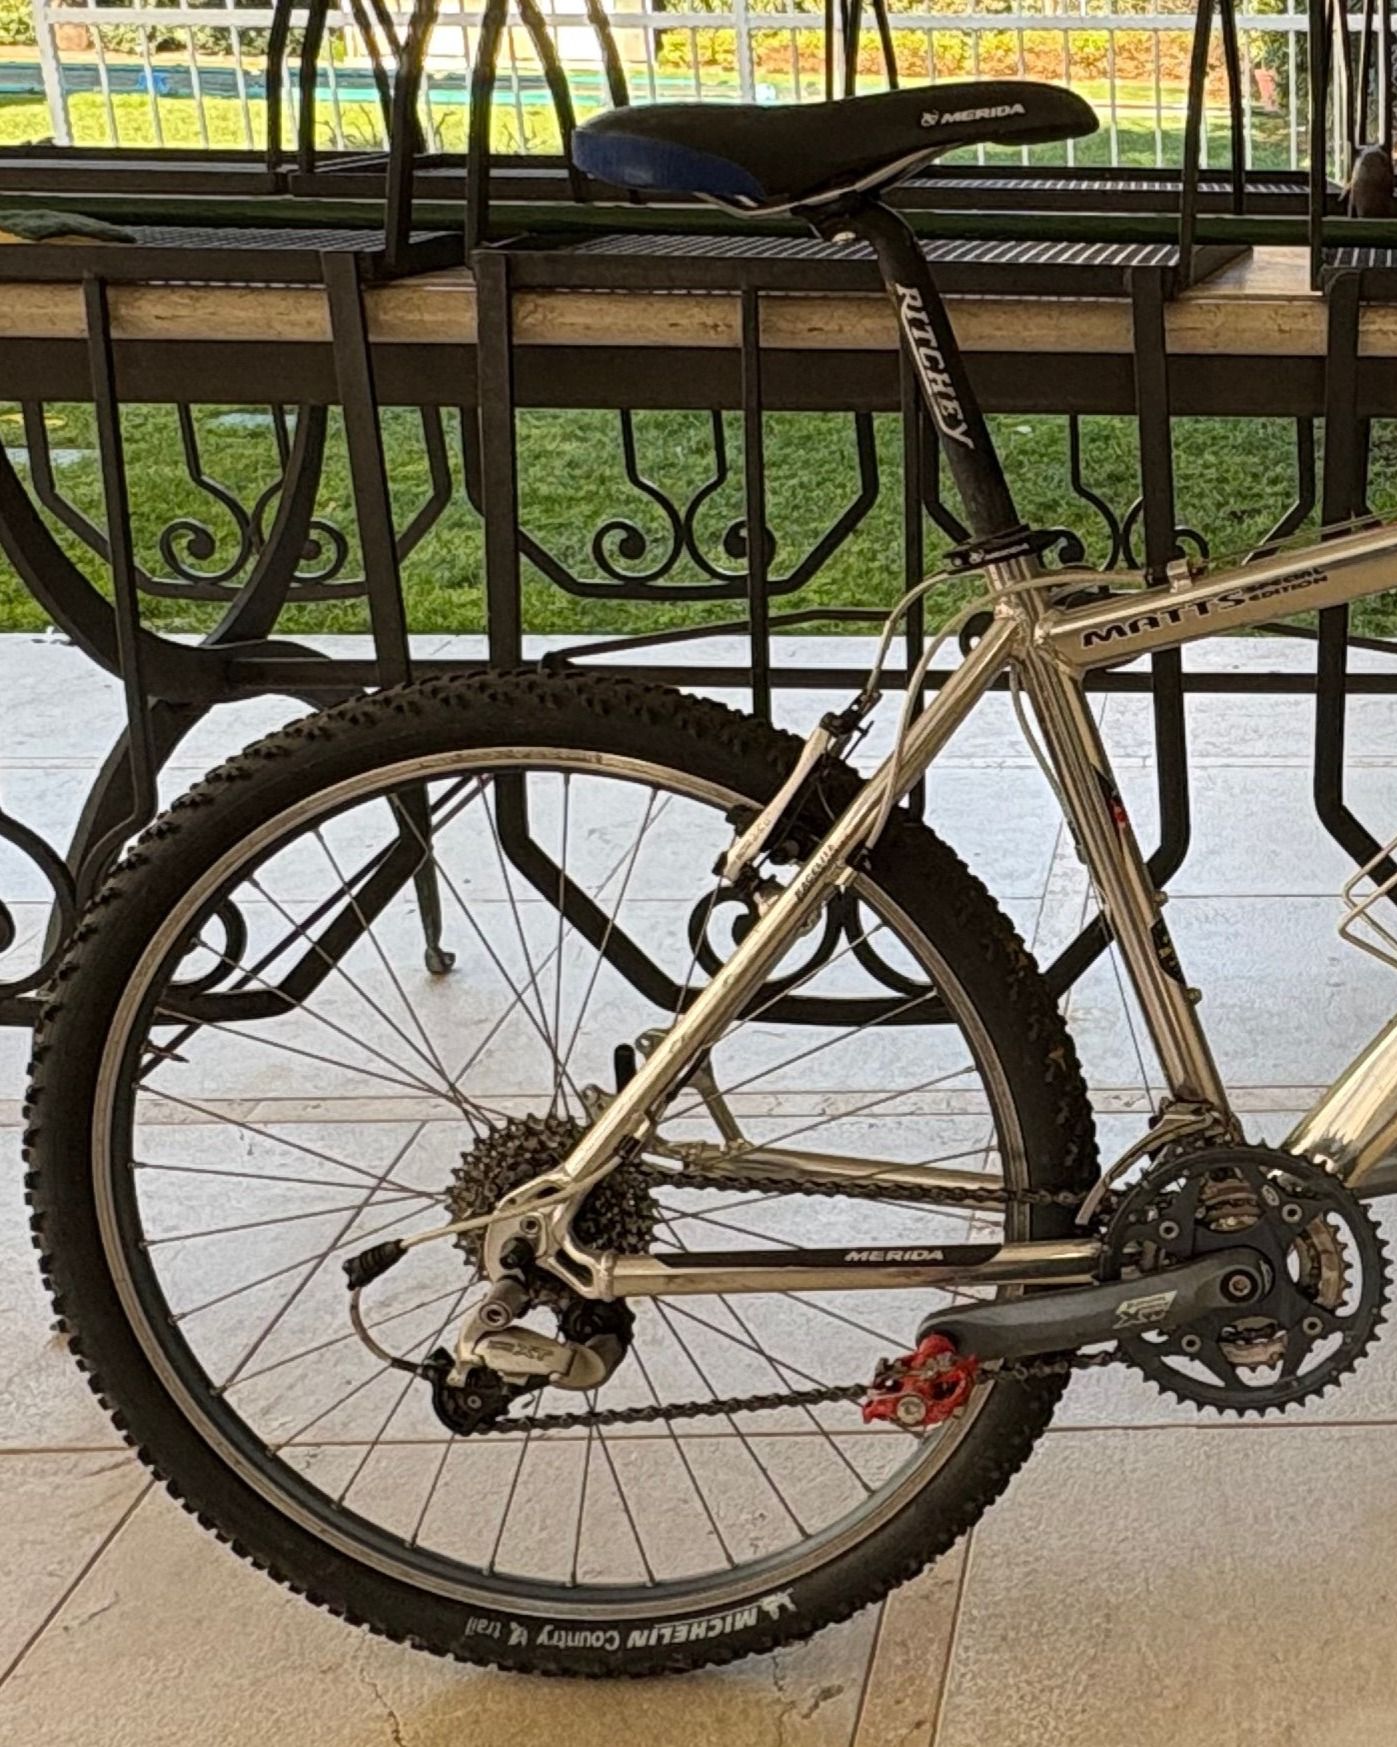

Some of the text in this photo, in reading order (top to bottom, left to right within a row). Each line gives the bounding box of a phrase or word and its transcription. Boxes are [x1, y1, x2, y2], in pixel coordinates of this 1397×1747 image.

[941, 103, 1026, 125] MERIDA
[895, 282, 976, 449] RITCHEY
[1248, 574, 1329, 601] EDITION
[1082, 589, 1246, 647] MATTS
[844, 1249, 945, 1262] MERIDA
[464, 1602, 762, 1651] MICHELIN Country trail
